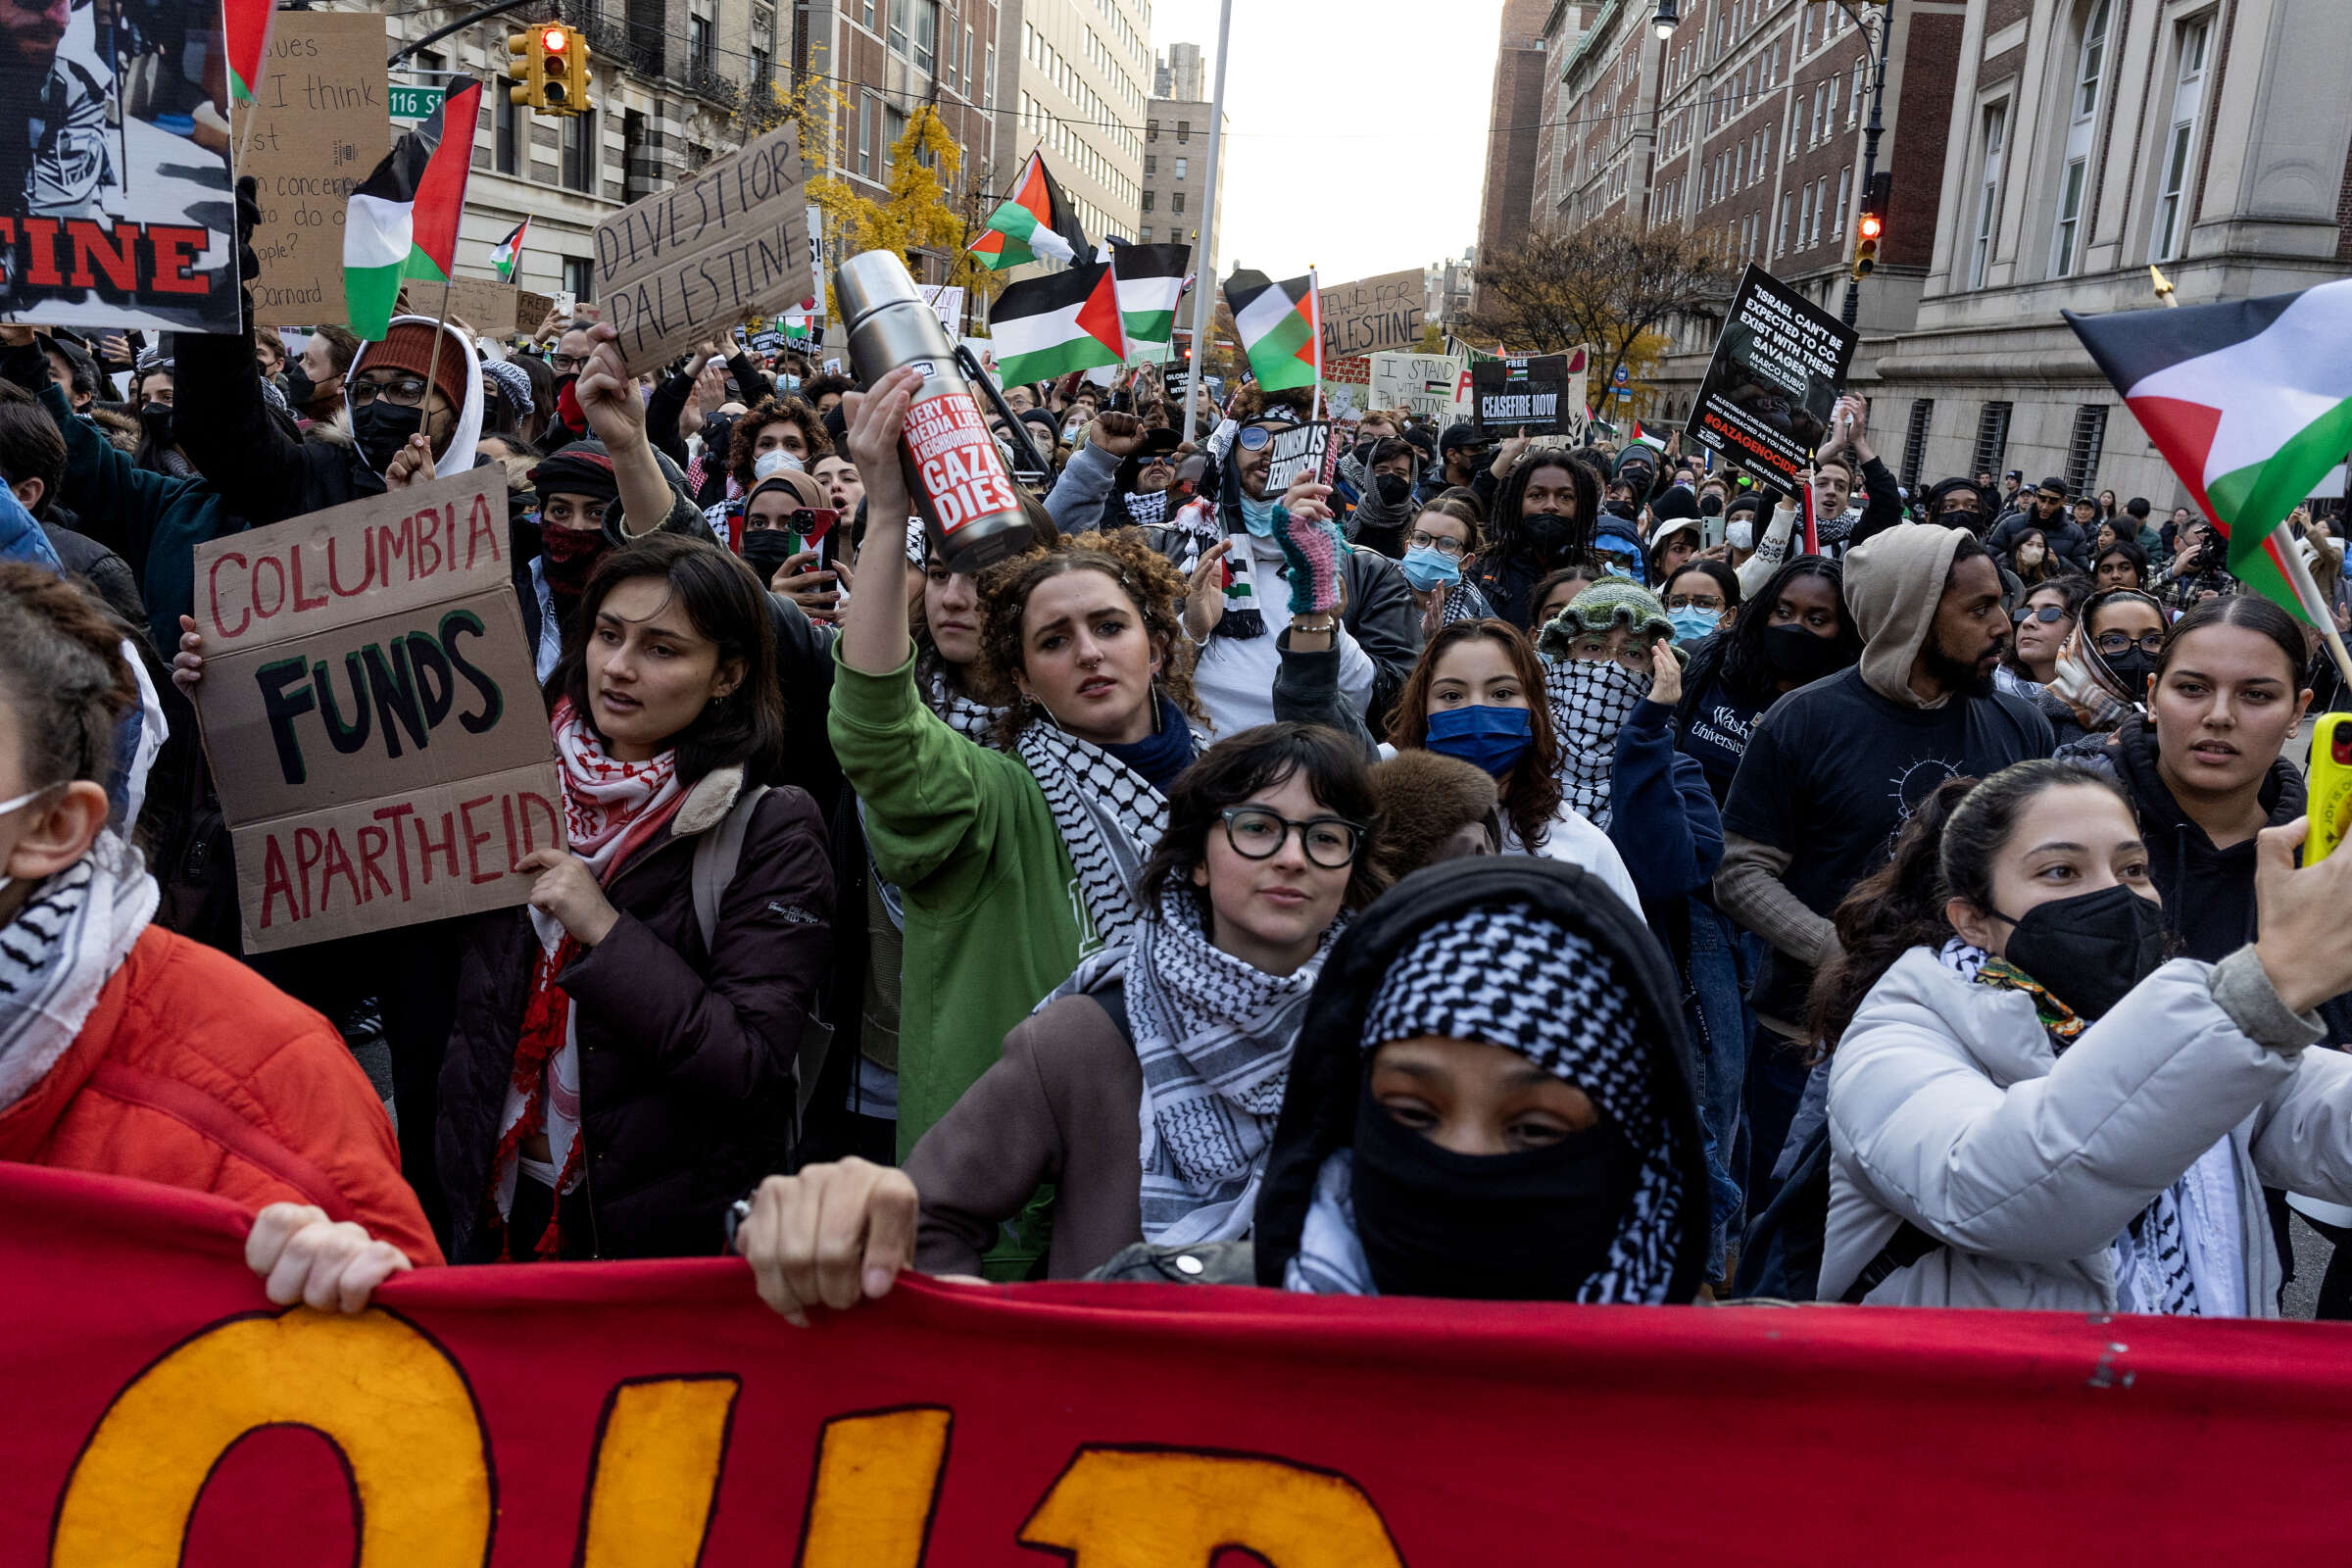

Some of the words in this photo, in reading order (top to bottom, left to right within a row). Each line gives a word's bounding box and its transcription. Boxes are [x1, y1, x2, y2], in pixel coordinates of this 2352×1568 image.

[270, 74, 288, 108] I
[302, 73, 381, 111] think
[391, 93, 417, 113] 116
[294, 200, 322, 226] do
[598, 169, 726, 282] DIVEST
[738, 140, 794, 213] FOR
[249, 274, 322, 311] Barnard
[611, 218, 801, 363] PALESTINE
[1376, 280, 1415, 312] FOR
[773, 331, 821, 354] GENOCIDE
[1740, 310, 1773, 338] EXIST
[1773, 331, 1801, 357] WITH
[1802, 350, 1836, 379] THESE
[1745, 297, 1799, 338] EXPECTED
[1801, 332, 1816, 350] TO
[1818, 344, 1839, 364] CO-
[1794, 314, 1830, 341] CAN'T
[1829, 336, 1843, 352] BE
[1380, 359, 1397, 377] I
[1408, 359, 1454, 380] STAND
[1505, 359, 1529, 368] FREE
[1749, 351, 1782, 376] MARCO
[1782, 371, 1806, 392] RUBIO
[1758, 367, 1780, 385] SENATOR
[1396, 381, 1421, 393] WITH
[1482, 395, 1531, 418] CEASEFIRE
[1532, 393, 1557, 416] NOW
[903, 398, 943, 431] EVERY
[944, 395, 978, 413] TIME
[906, 415, 955, 448] MEDIA
[954, 412, 984, 428] LIES
[1712, 393, 1747, 417] PALESTINIAN
[1746, 415, 1773, 432] CHILDREN
[1779, 434, 1795, 449] GAZA
[1794, 445, 1807, 456] ARE
[1271, 425, 1310, 463] ZIONISM
[1308, 424, 1328, 455] IS
[1703, 413, 1798, 476] #GAZAGENOCIDE
[1706, 400, 1723, 415] BEING
[1757, 432, 1767, 441] AS
[1767, 437, 1779, 449] YOU
[1779, 445, 1794, 457] READ
[1792, 454, 1806, 466] THIS
[922, 443, 1005, 496] GAZA
[933, 475, 1018, 531] DIES
[209, 493, 502, 639] COLUMBIA
[255, 610, 504, 785] FUNDS
[1691, 720, 1745, 758] University
[260, 792, 561, 929] APARTHEID
